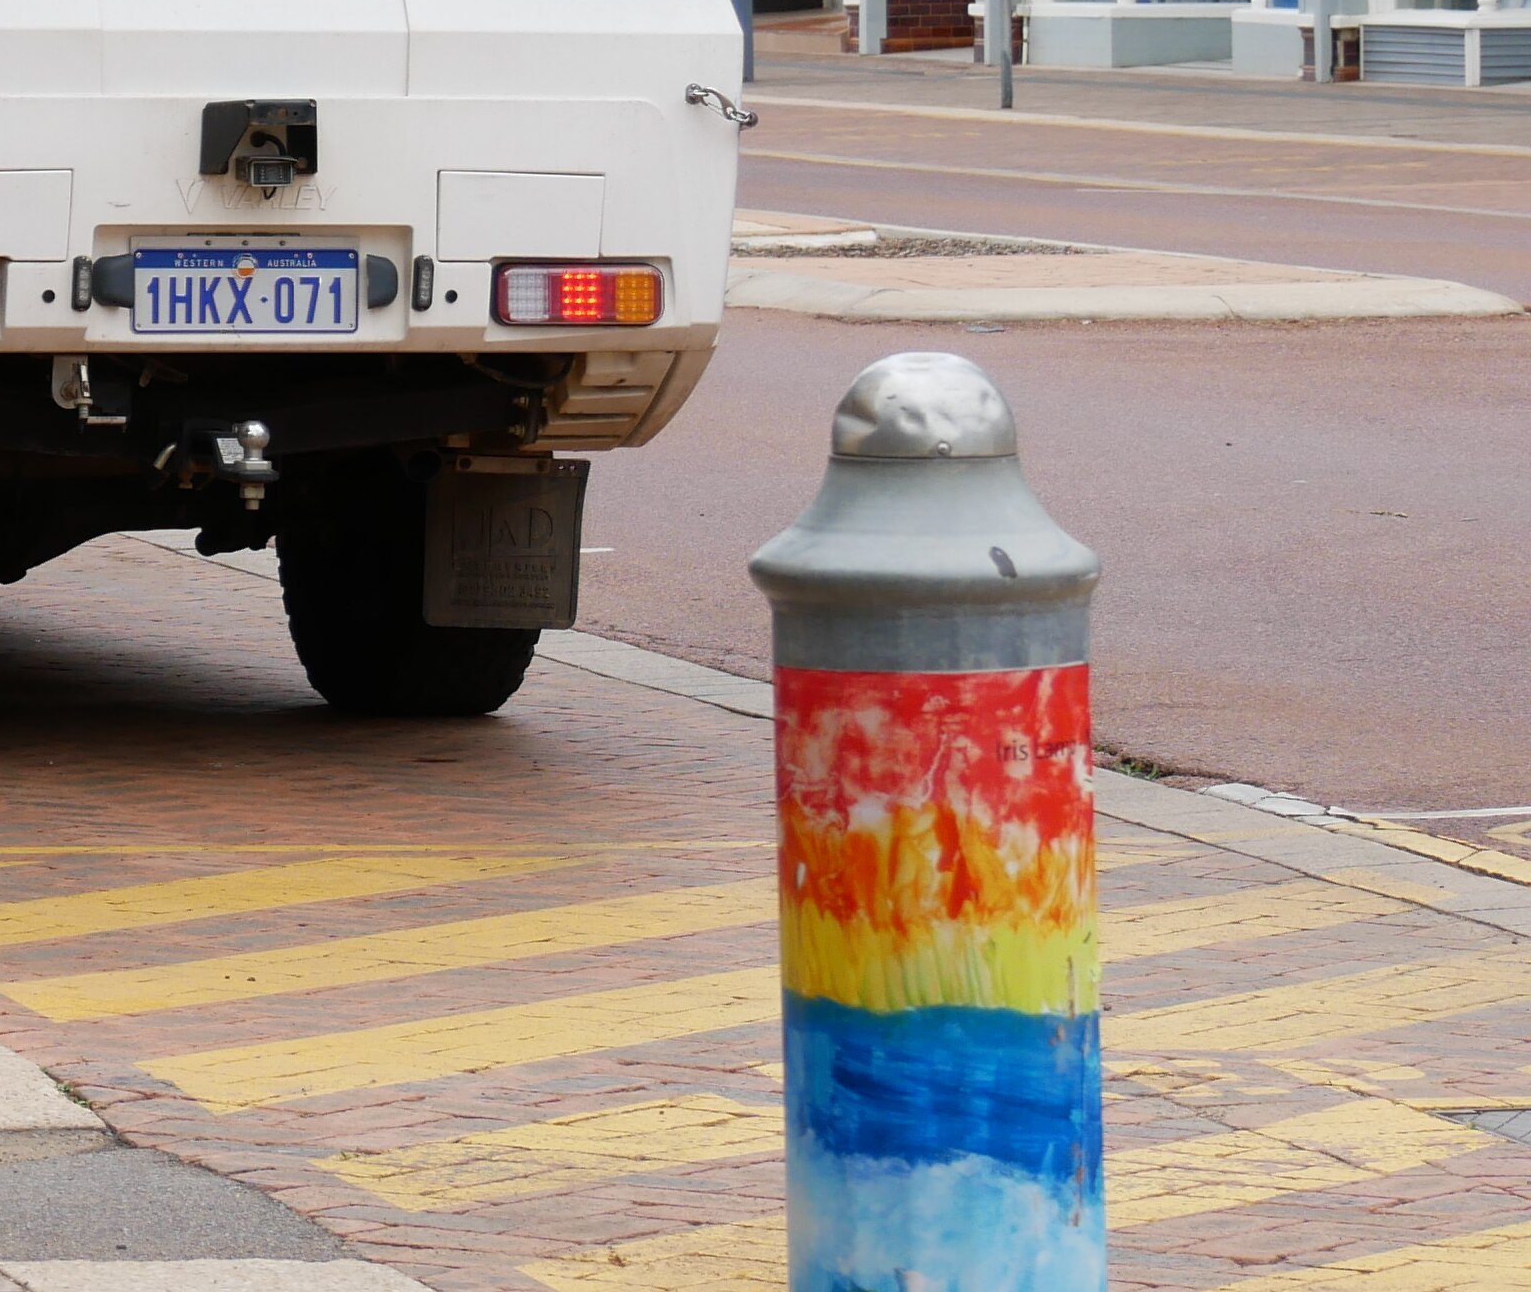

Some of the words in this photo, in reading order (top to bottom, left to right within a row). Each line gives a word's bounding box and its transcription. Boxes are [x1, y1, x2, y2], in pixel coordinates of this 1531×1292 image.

[174, 259, 224, 268] WESTERN
[267, 259, 317, 268] AUSTRALIA
[996, 739, 1029, 761] Iris
